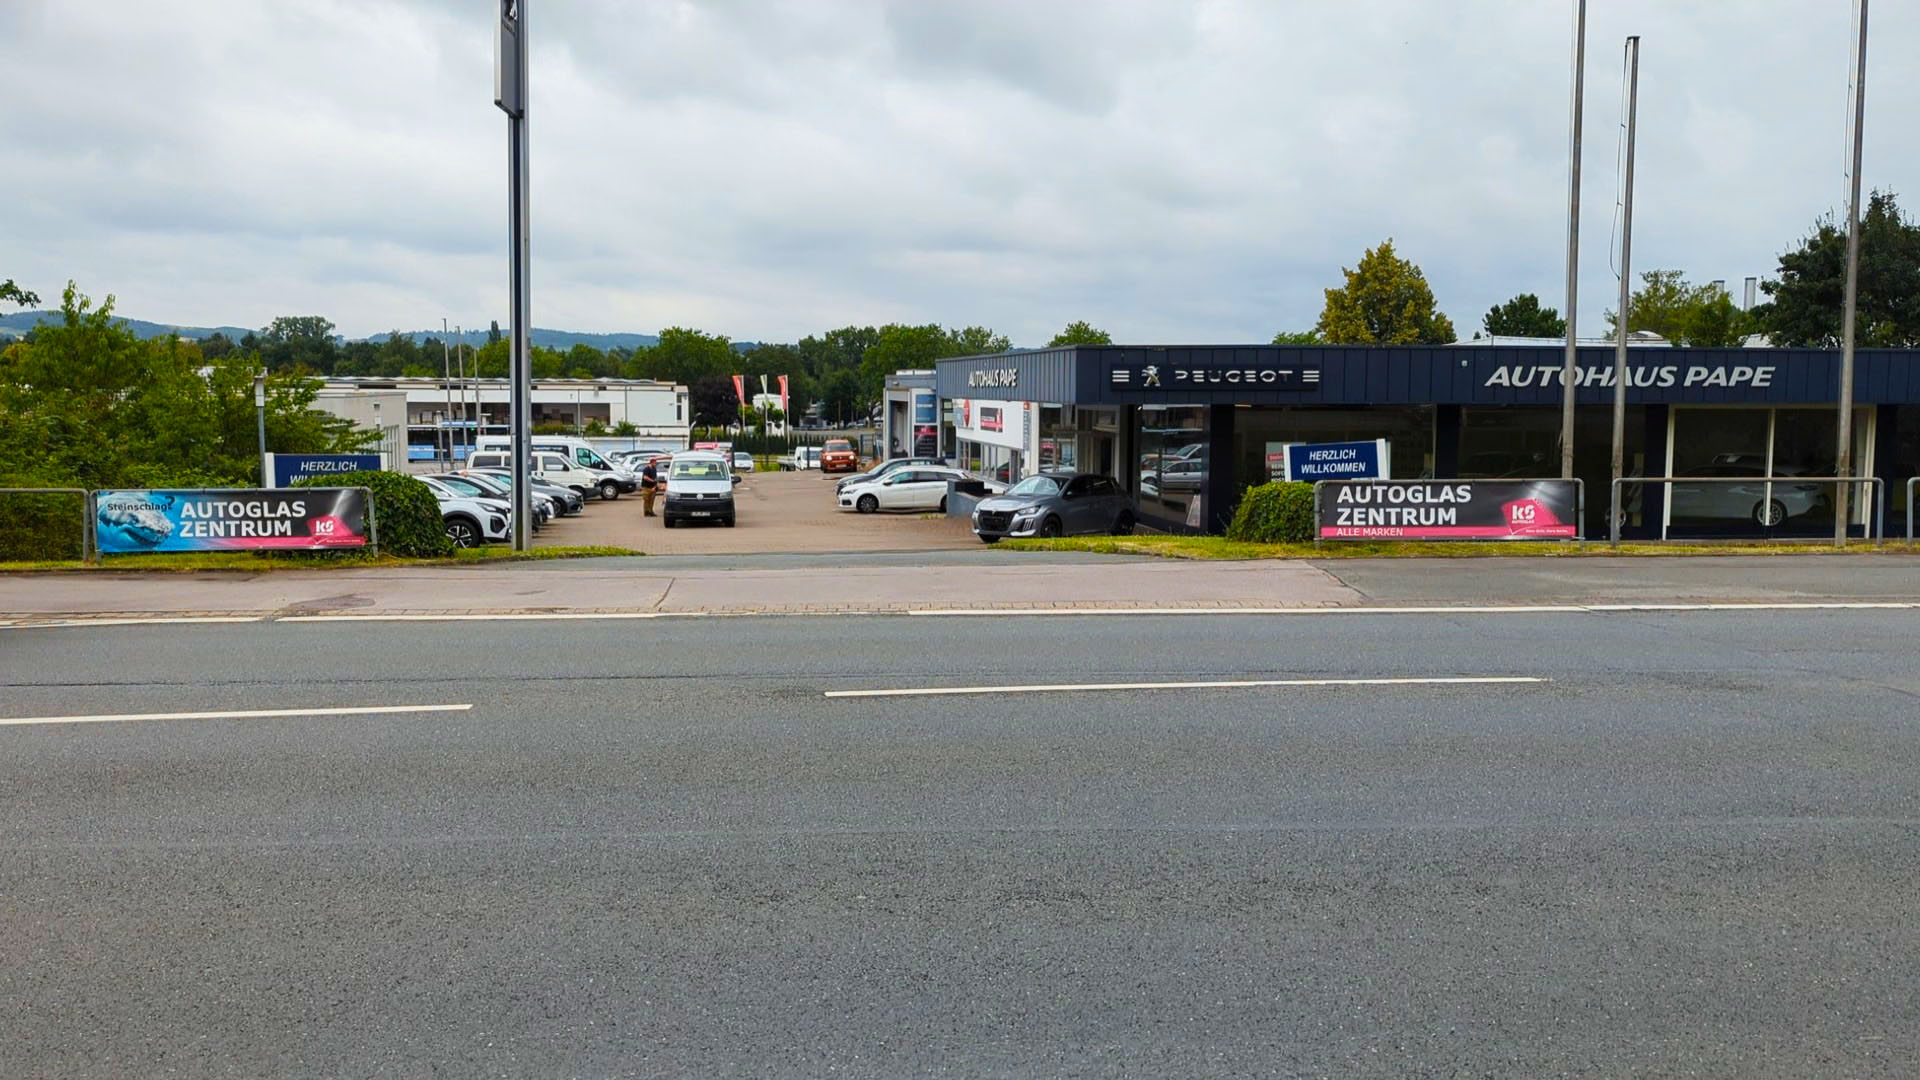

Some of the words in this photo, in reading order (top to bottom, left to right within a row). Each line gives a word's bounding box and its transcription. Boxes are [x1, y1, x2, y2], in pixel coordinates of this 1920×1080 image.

[968, 369, 999, 388] AUTOHAUS
[1000, 368, 1017, 387] PAPE
[1174, 370, 1294, 383] PEUGEOT
[1484, 366, 1678, 387] AUTOHAUS
[1683, 366, 1776, 387] PAPE
[1309, 450, 1356, 461] HERZLICH
[300, 461, 357, 472] HERZLICH
[1301, 462, 1367, 474] WILLKOMMEN
[1336, 485, 1472, 504] AUTOGLAS
[180, 501, 307, 518] AUTOGLAS
[1336, 507, 1457, 526] ZENTRUM
[179, 520, 292, 537] ZENTRUM
[1336, 528, 1360, 536] ALLE
[1362, 528, 1404, 536] MARKEN
